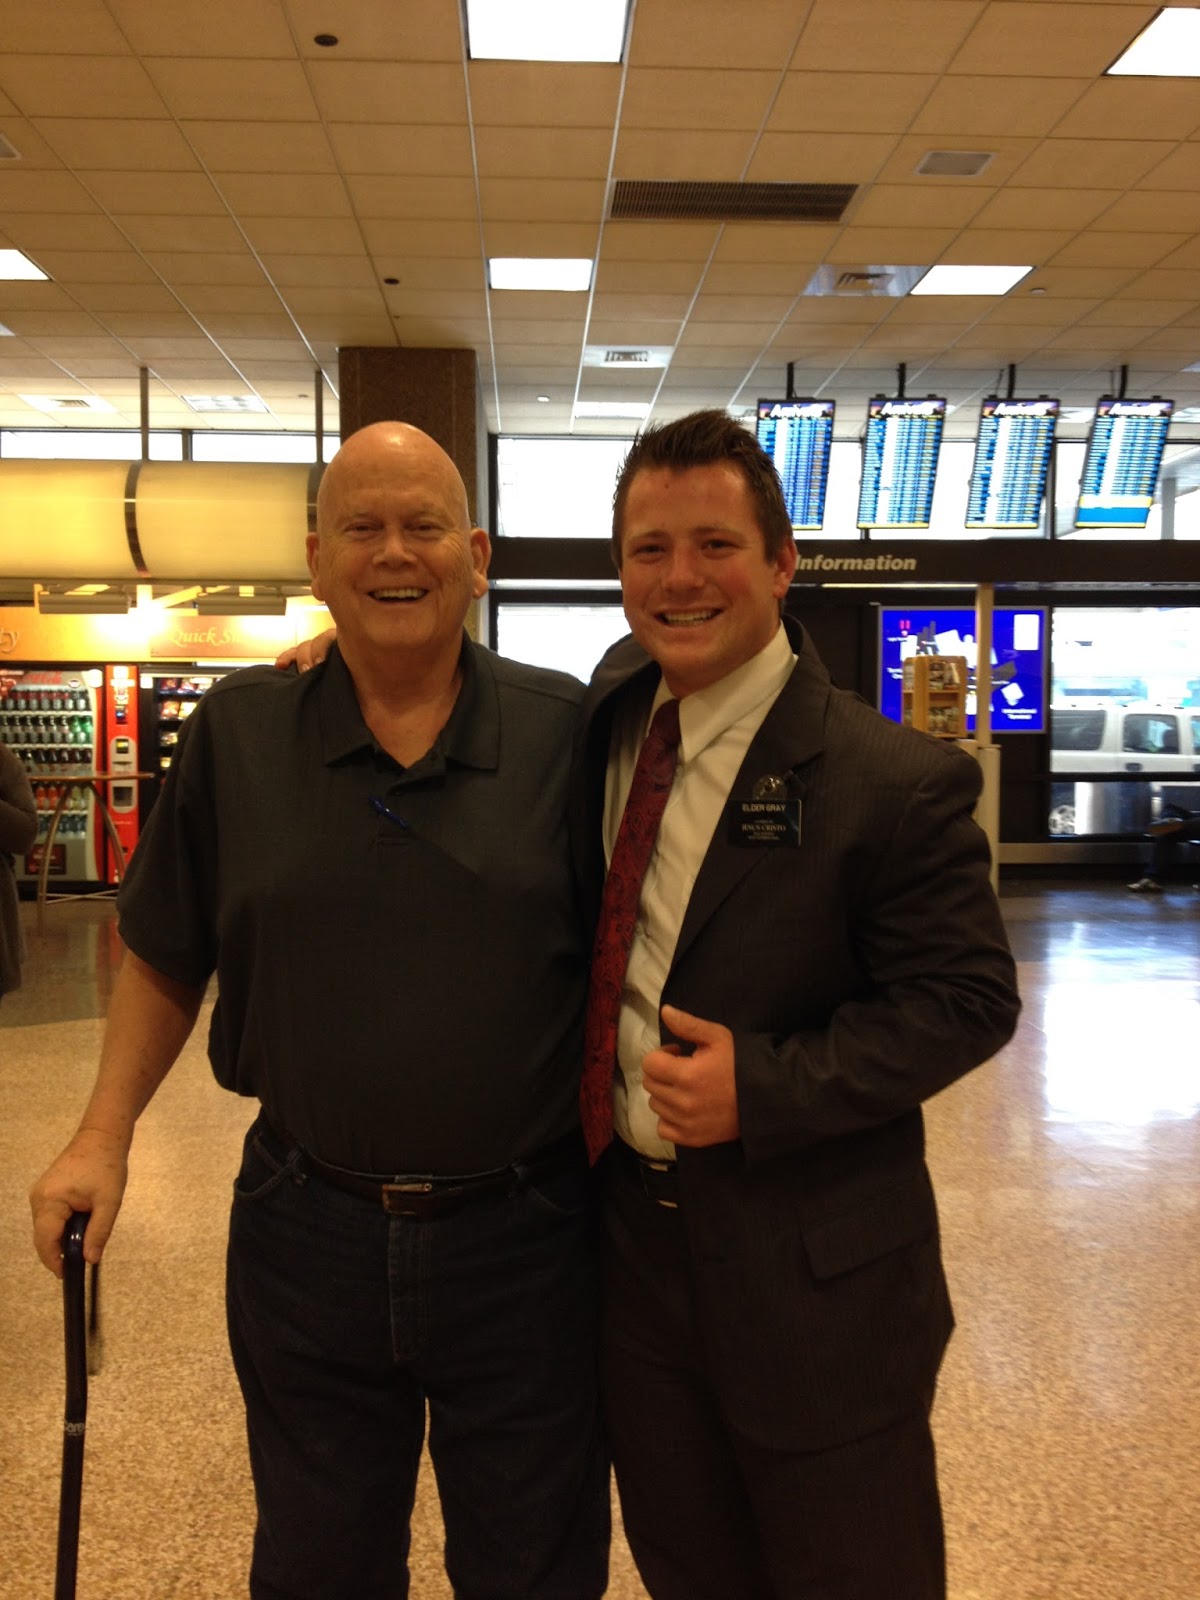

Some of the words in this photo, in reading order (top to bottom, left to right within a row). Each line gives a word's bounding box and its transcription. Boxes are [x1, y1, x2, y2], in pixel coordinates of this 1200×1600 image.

[796, 554, 917, 571] Information
[170, 626, 219, 647] Quick
[742, 803, 765, 812] ELDER
[765, 803, 786, 812] GRAY
